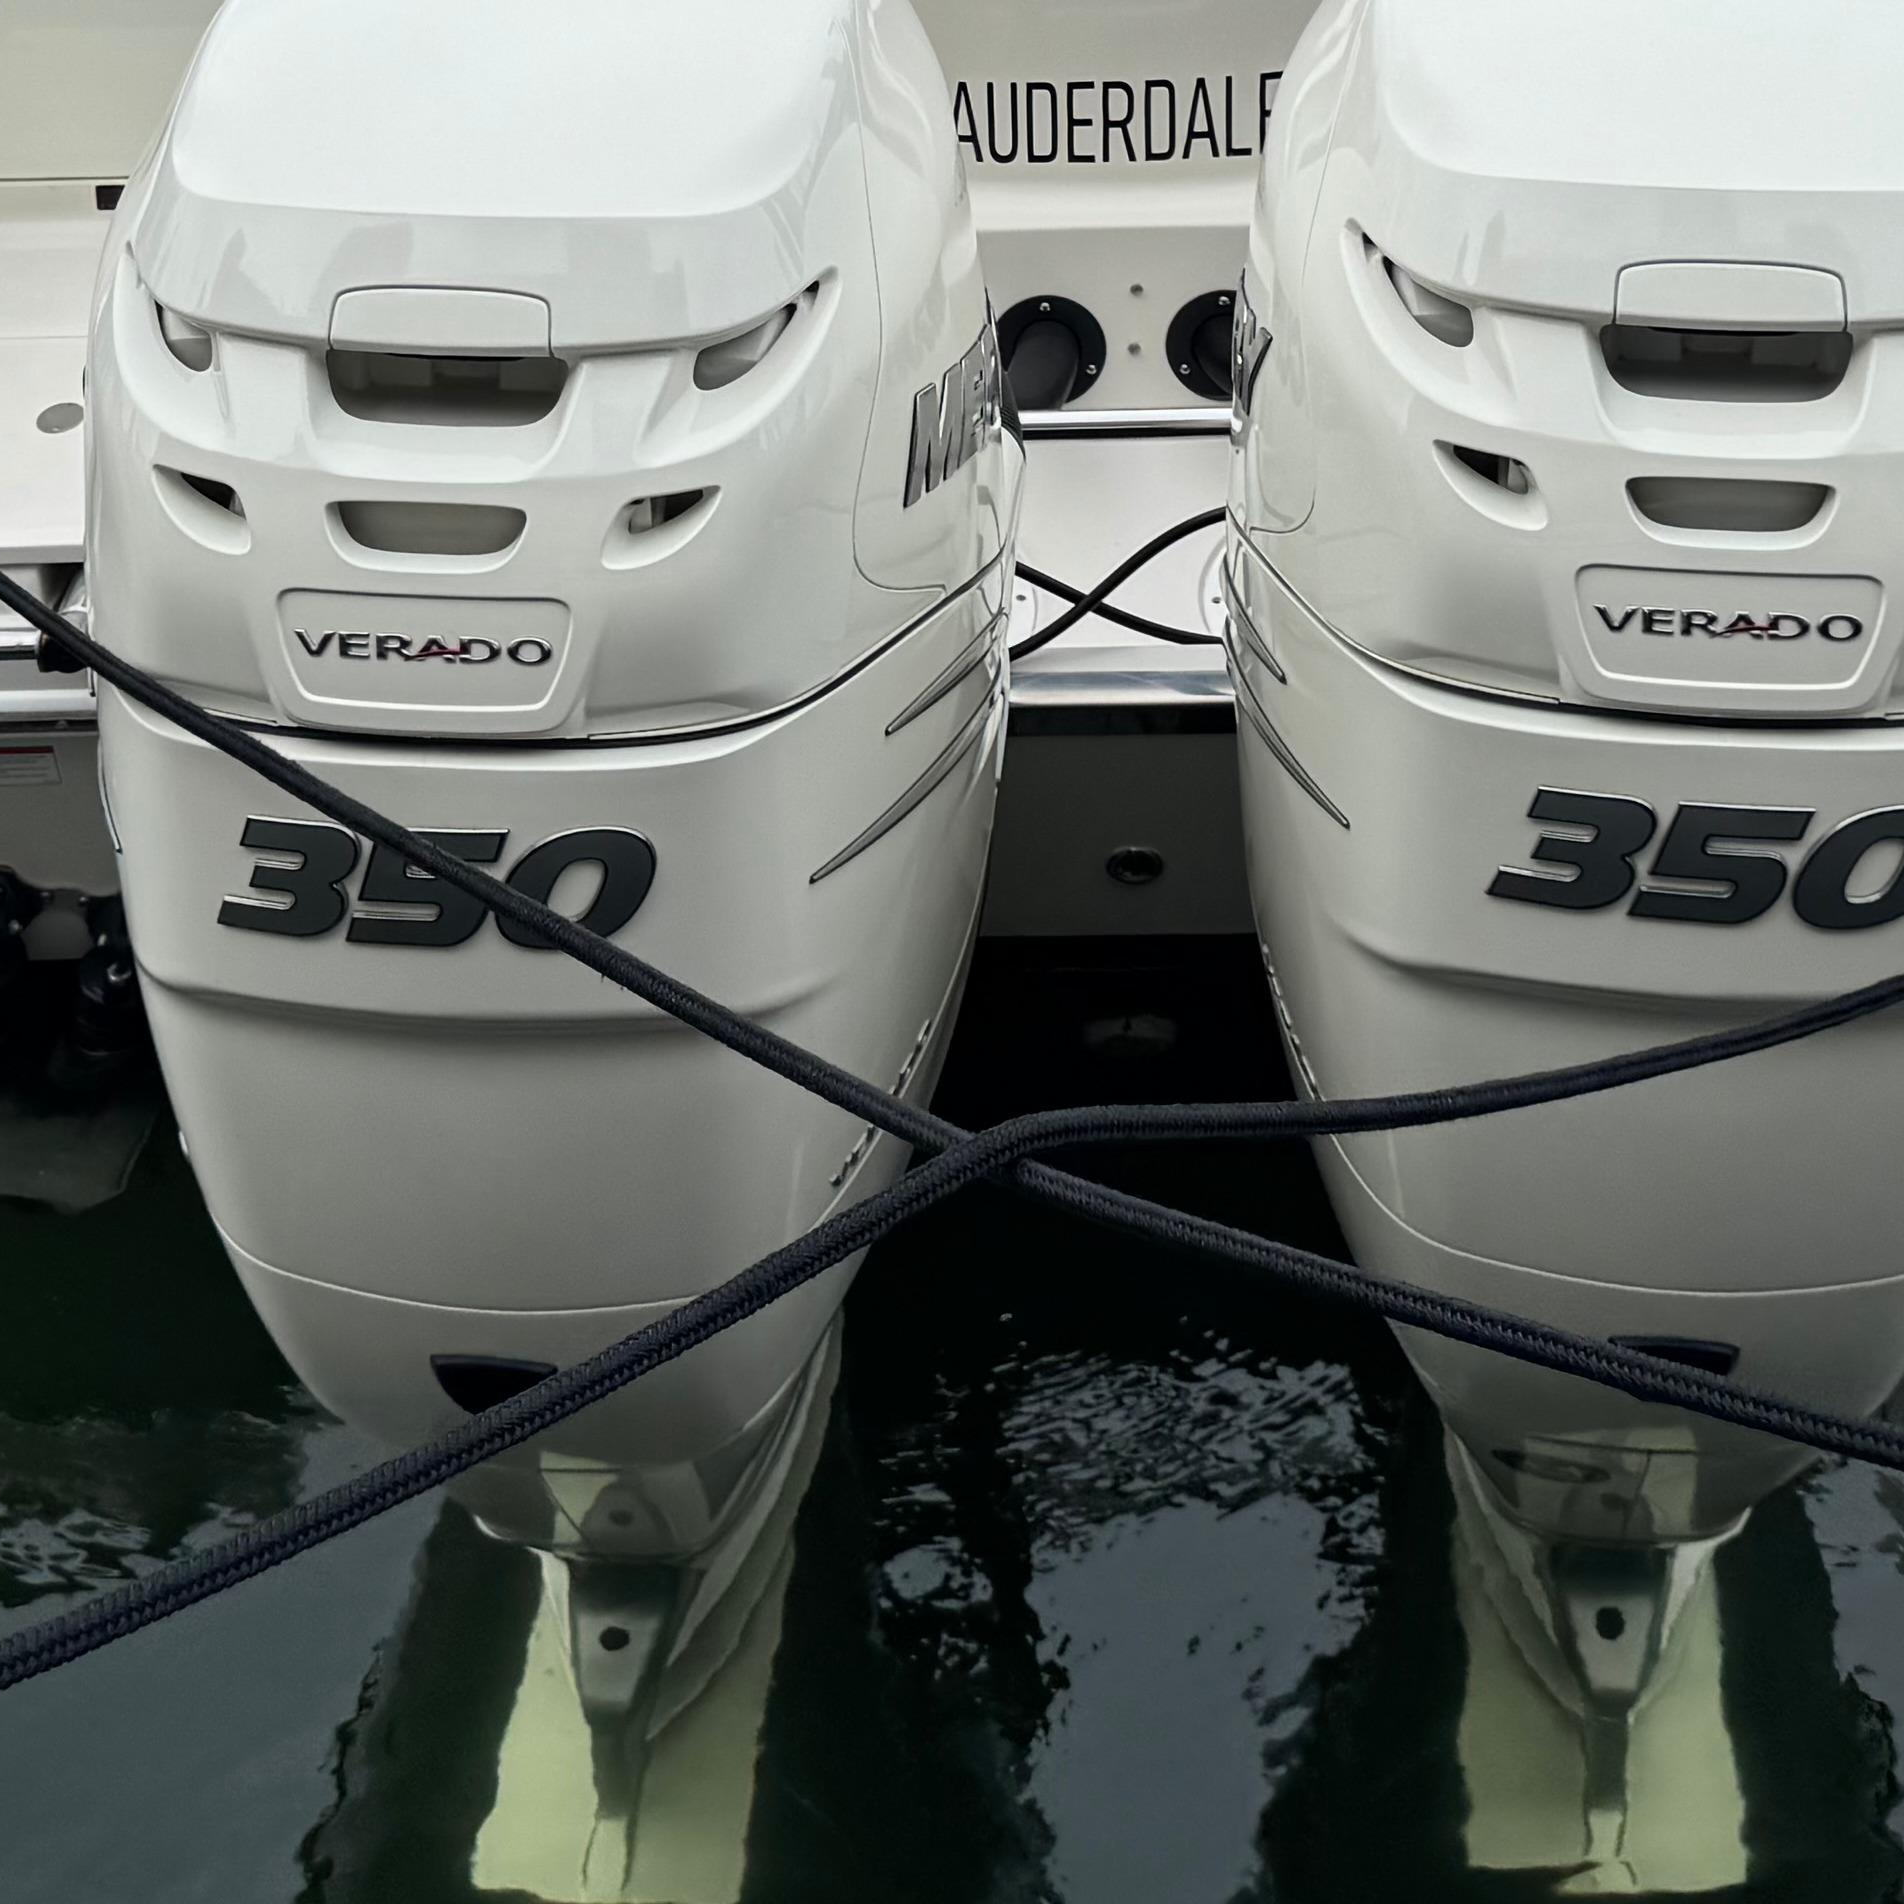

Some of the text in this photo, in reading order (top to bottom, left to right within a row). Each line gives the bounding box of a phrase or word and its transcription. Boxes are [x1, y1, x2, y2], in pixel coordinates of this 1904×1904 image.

[953, 69, 1284, 164] AUDERDALE
[294, 628, 553, 667] VERADO
[1592, 604, 1864, 642] VERADO
[217, 814, 658, 950] 350
